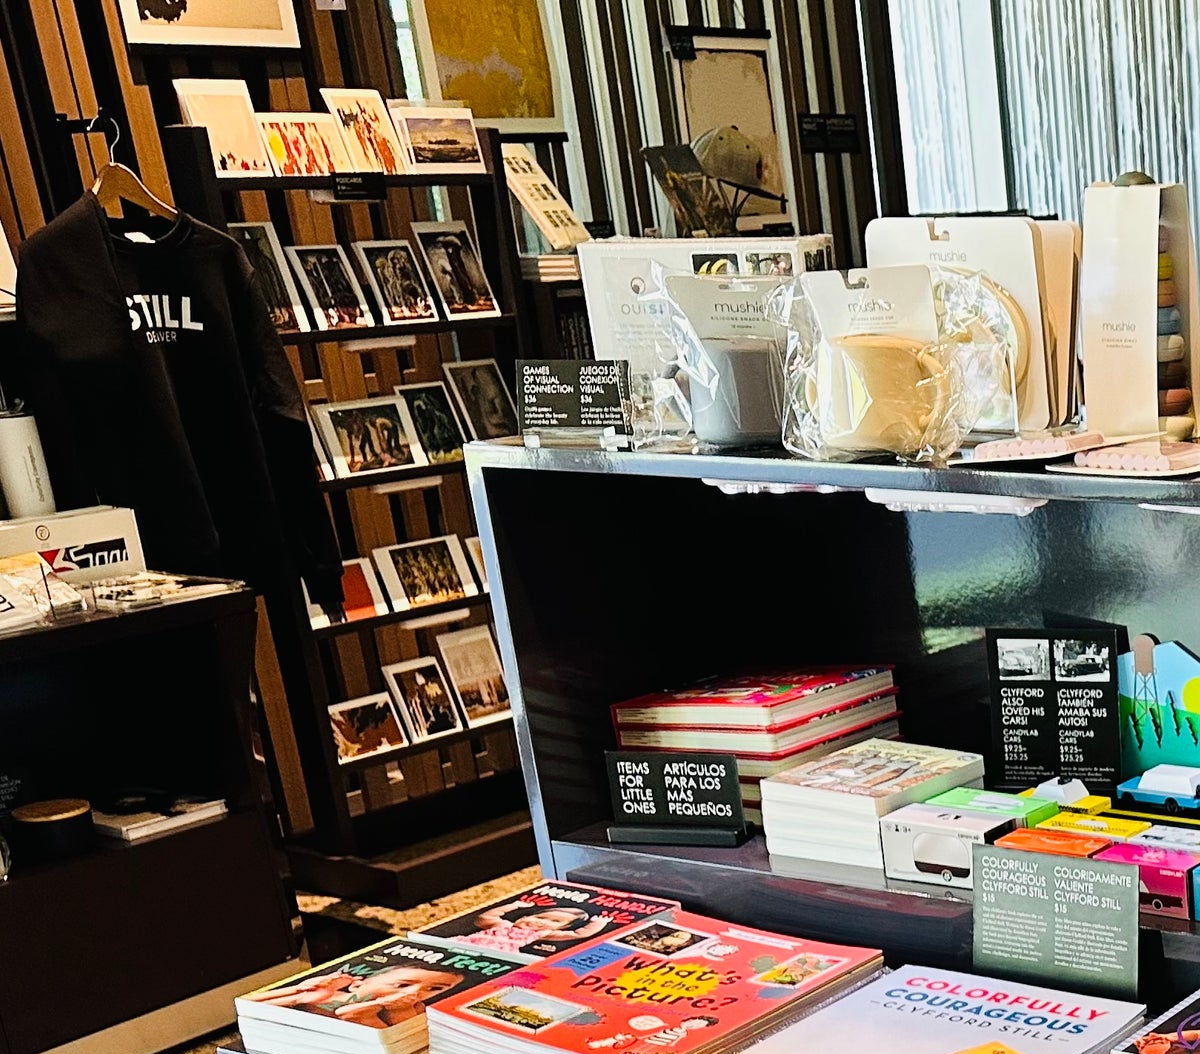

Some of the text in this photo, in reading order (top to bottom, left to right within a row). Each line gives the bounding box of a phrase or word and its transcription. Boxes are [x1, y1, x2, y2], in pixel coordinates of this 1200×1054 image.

[929, 250, 967, 262] mushie
[1102, 320, 1136, 332] mushie
[523, 365, 550, 375] GAMES
[579, 365, 609, 375] JUEGOS
[523, 375, 560, 385] OF VISUAL
[523, 384, 574, 394] CONNECTION
[580, 384, 605, 394] VISUAL
[1001, 688, 1045, 697] CLYFFORD
[1001, 697, 1024, 707] ALSO
[1001, 707, 1045, 716] LOVED HIS
[1058, 708, 1108, 718] AMABA SUS
[1003, 728, 1039, 736] CANDYLAB
[1059, 729, 1095, 738] CANDYLAB
[1059, 737, 1077, 745] CARS
[1004, 753, 1028, 761] $25.25
[1060, 754, 1084, 762] $25.25
[616, 761, 650, 775] ITEMS
[663, 760, 726, 777] ARTÍCULOS
[619, 774, 644, 788] FOR
[664, 776, 721, 790] PARA LOS
[620, 788, 654, 801] LITTLE
[667, 787, 694, 802] MÁS
[623, 801, 657, 815] ONES
[668, 801, 733, 817] PEQUEÑOS
[981, 855, 1039, 874] COLORFULLY
[981, 868, 1047, 887] COURAGEOUS
[1053, 866, 1132, 888] COLORIDAMENTE
[982, 880, 1049, 900] CLYFFORD STILL
[1054, 879, 1094, 894] VALIENTE
[982, 892, 996, 903] $15
[1054, 890, 1122, 910] CLYFFORD STILL
[1054, 903, 1068, 914] $15
[622, 955, 743, 987] What's
[635, 974, 700, 992] in the
[570, 974, 739, 1012] Picture?
[905, 976, 1110, 1022] COLORFULLY
[884, 988, 1090, 1035] COURAGEOUS
[883, 1001, 1054, 1042] CLYFFORD STILL
